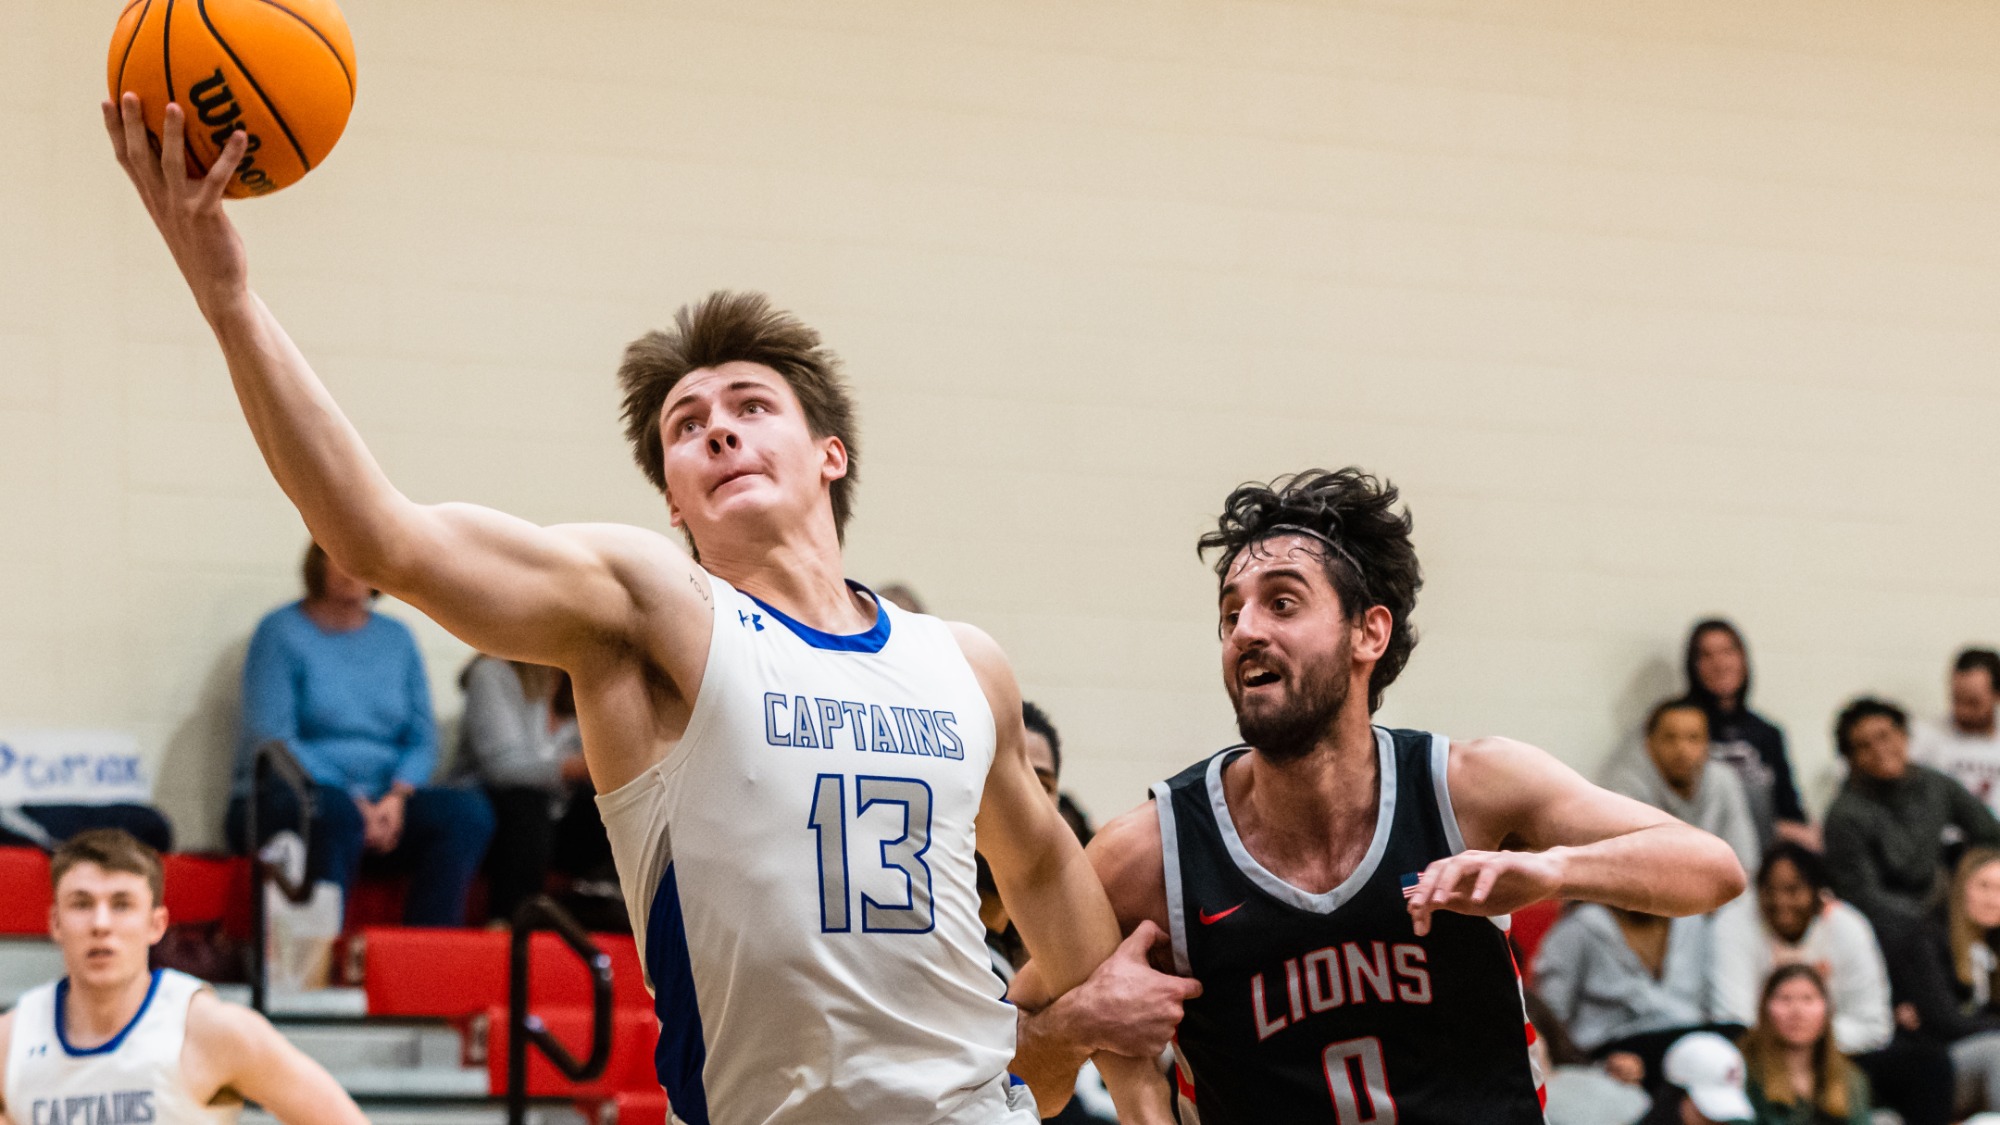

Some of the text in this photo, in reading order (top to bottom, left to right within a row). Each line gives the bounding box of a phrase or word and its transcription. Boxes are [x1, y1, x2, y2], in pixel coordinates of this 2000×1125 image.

[764, 692, 964, 761] CAPTAINS
[807, 773, 935, 934] 13
[1251, 941, 1432, 1043] LIONS
[32, 1090, 155, 1125] CAPTAINS
[1322, 1036, 1399, 1125] 0
